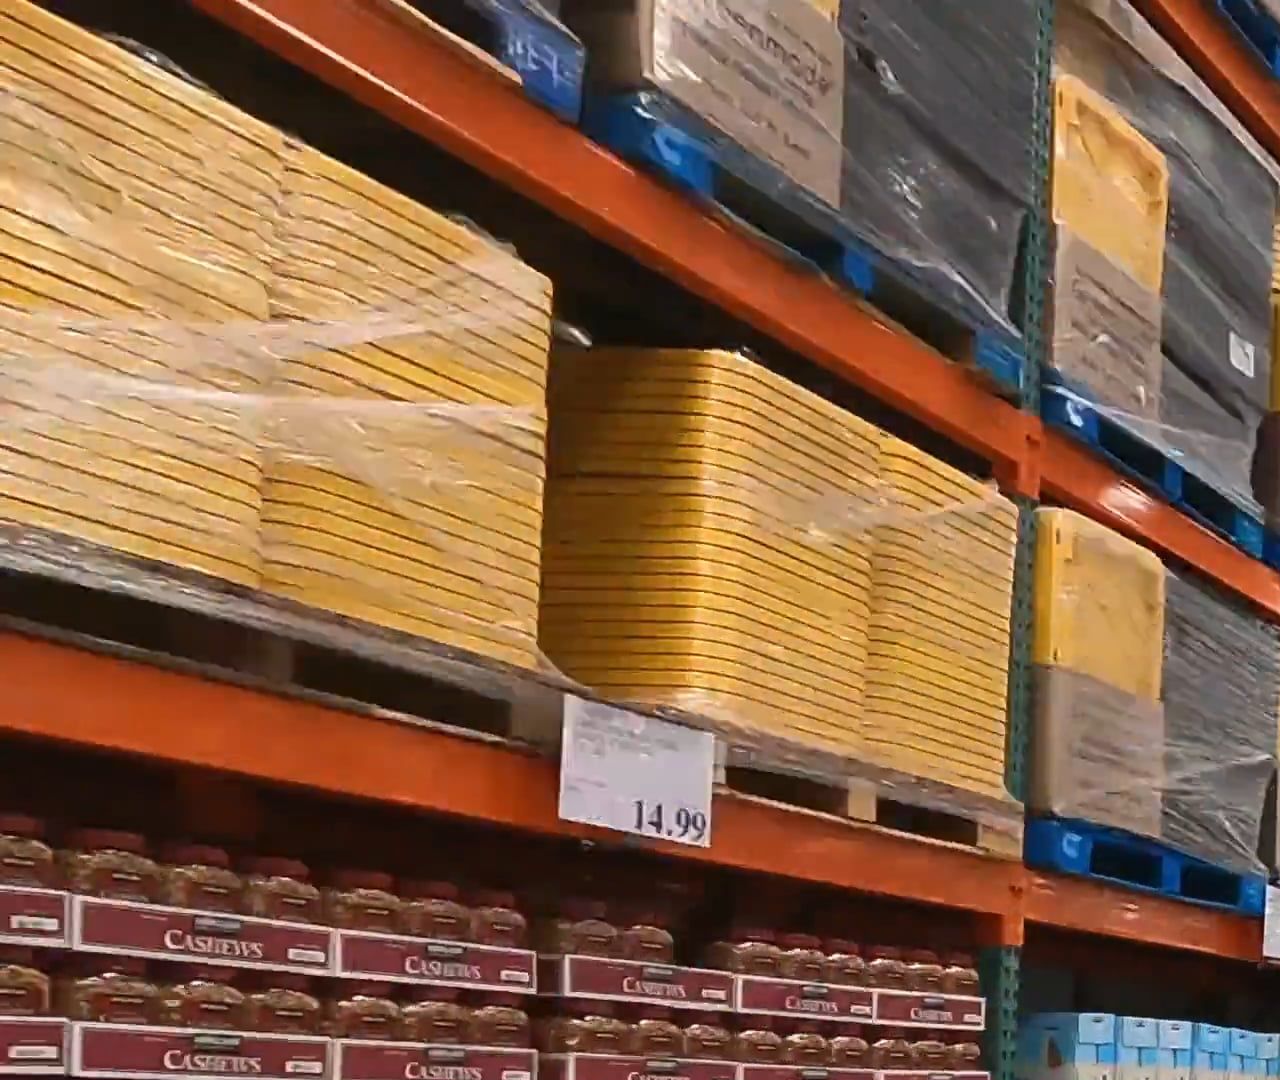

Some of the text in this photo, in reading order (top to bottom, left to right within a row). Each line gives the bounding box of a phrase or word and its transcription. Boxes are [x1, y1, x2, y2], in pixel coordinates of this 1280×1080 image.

[633, 800, 706, 839] 14.99
[164, 929, 263, 958] CASHEWS
[405, 956, 480, 979] CASHEWS
[164, 1050, 261, 1072] CASHEWS
